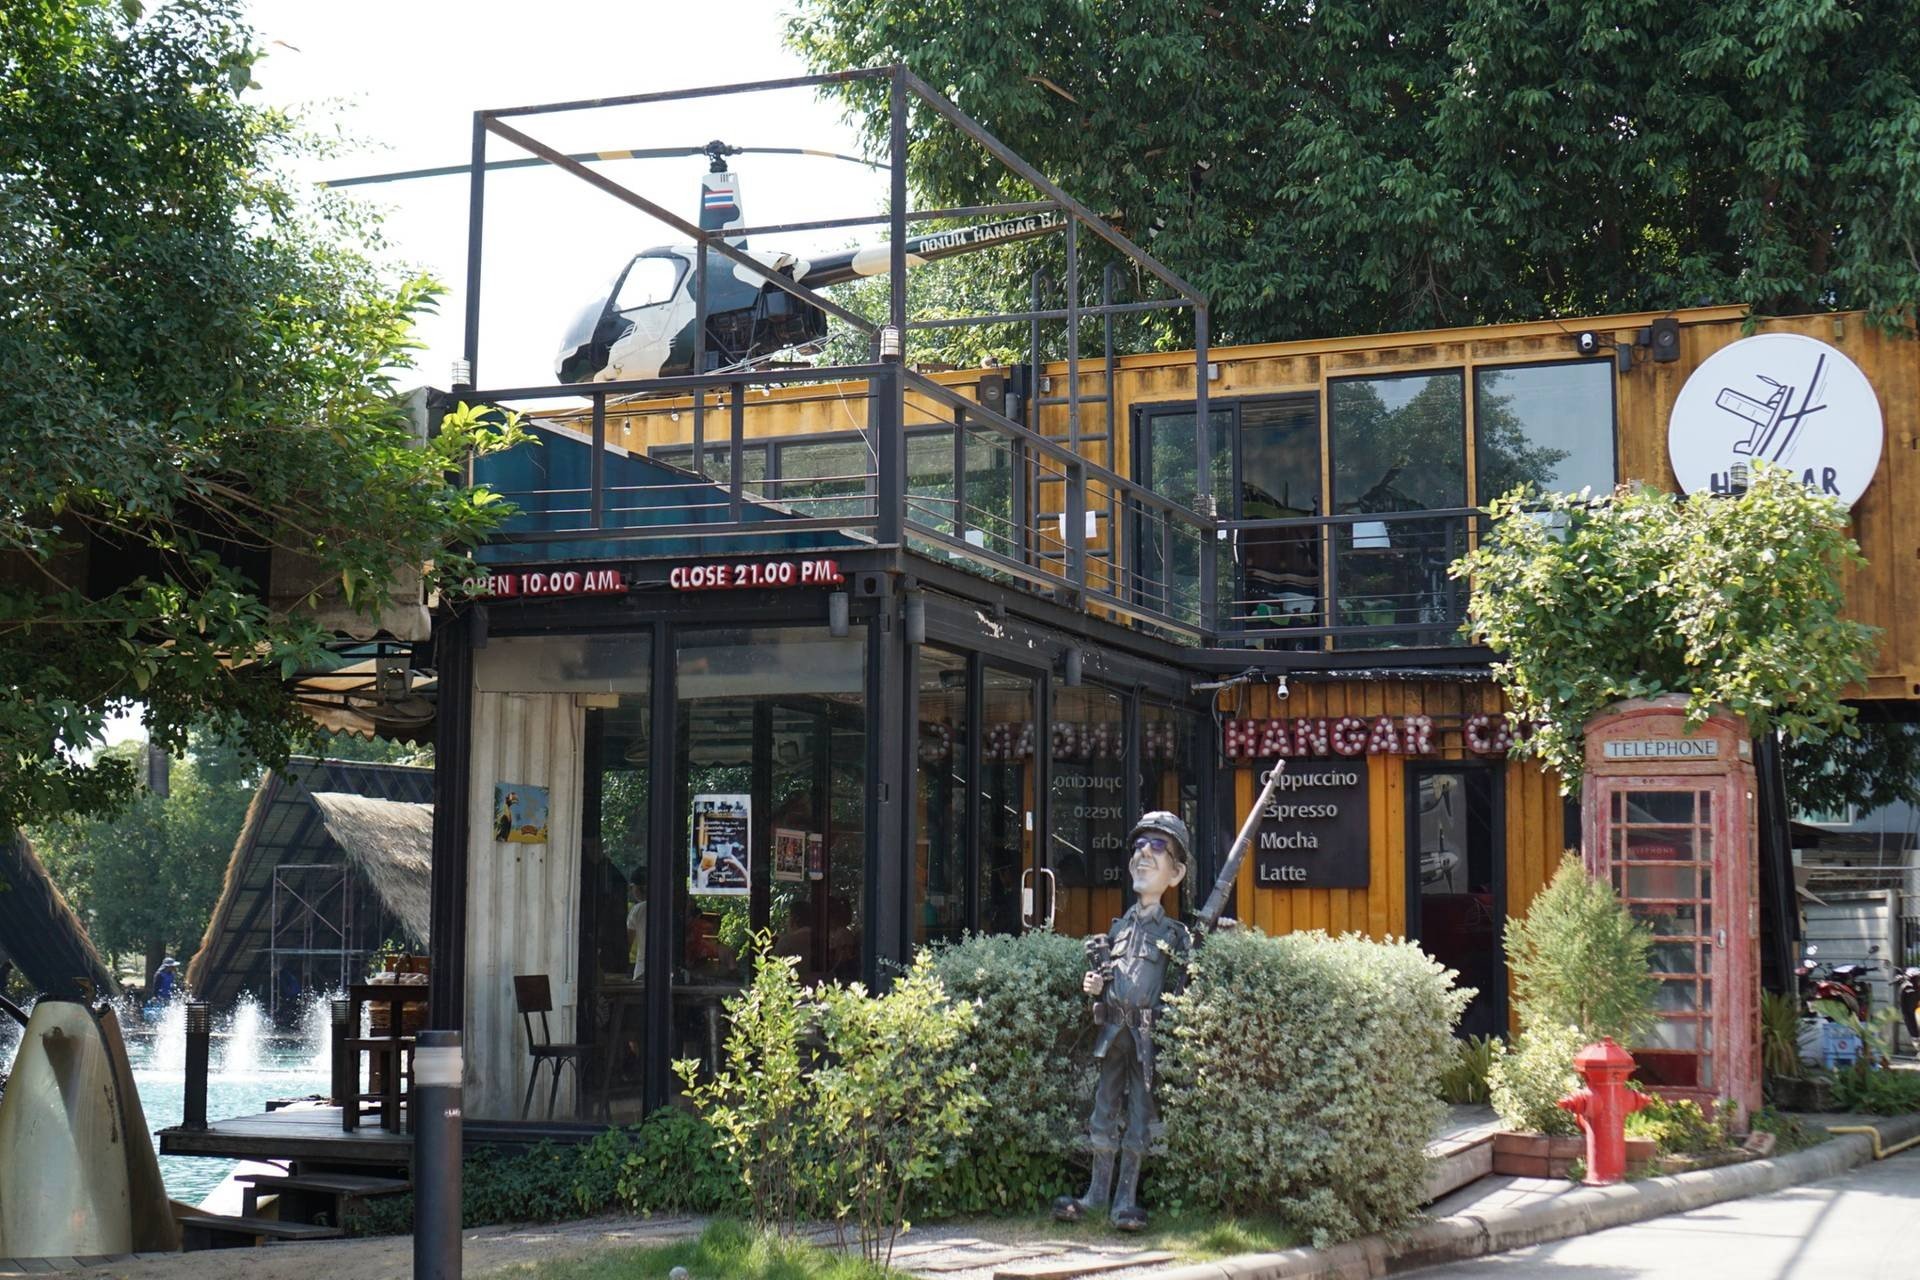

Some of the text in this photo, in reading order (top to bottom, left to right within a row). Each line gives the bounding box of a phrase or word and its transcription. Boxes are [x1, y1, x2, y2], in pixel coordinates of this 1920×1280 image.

[973, 217, 1036, 242] HANGAR
[1711, 467, 1840, 496] HAR
[462, 570, 620, 596] OPEN 10.00 AM.
[670, 560, 838, 588] CLOSE 21.00 PM.
[1225, 714, 1437, 757] HANGAR
[1609, 740, 1716, 757] TELEPHONE
[1260, 769, 1358, 791] Cppuccino
[1260, 831, 1318, 849] Mocha
[1260, 864, 1307, 881] Latte
